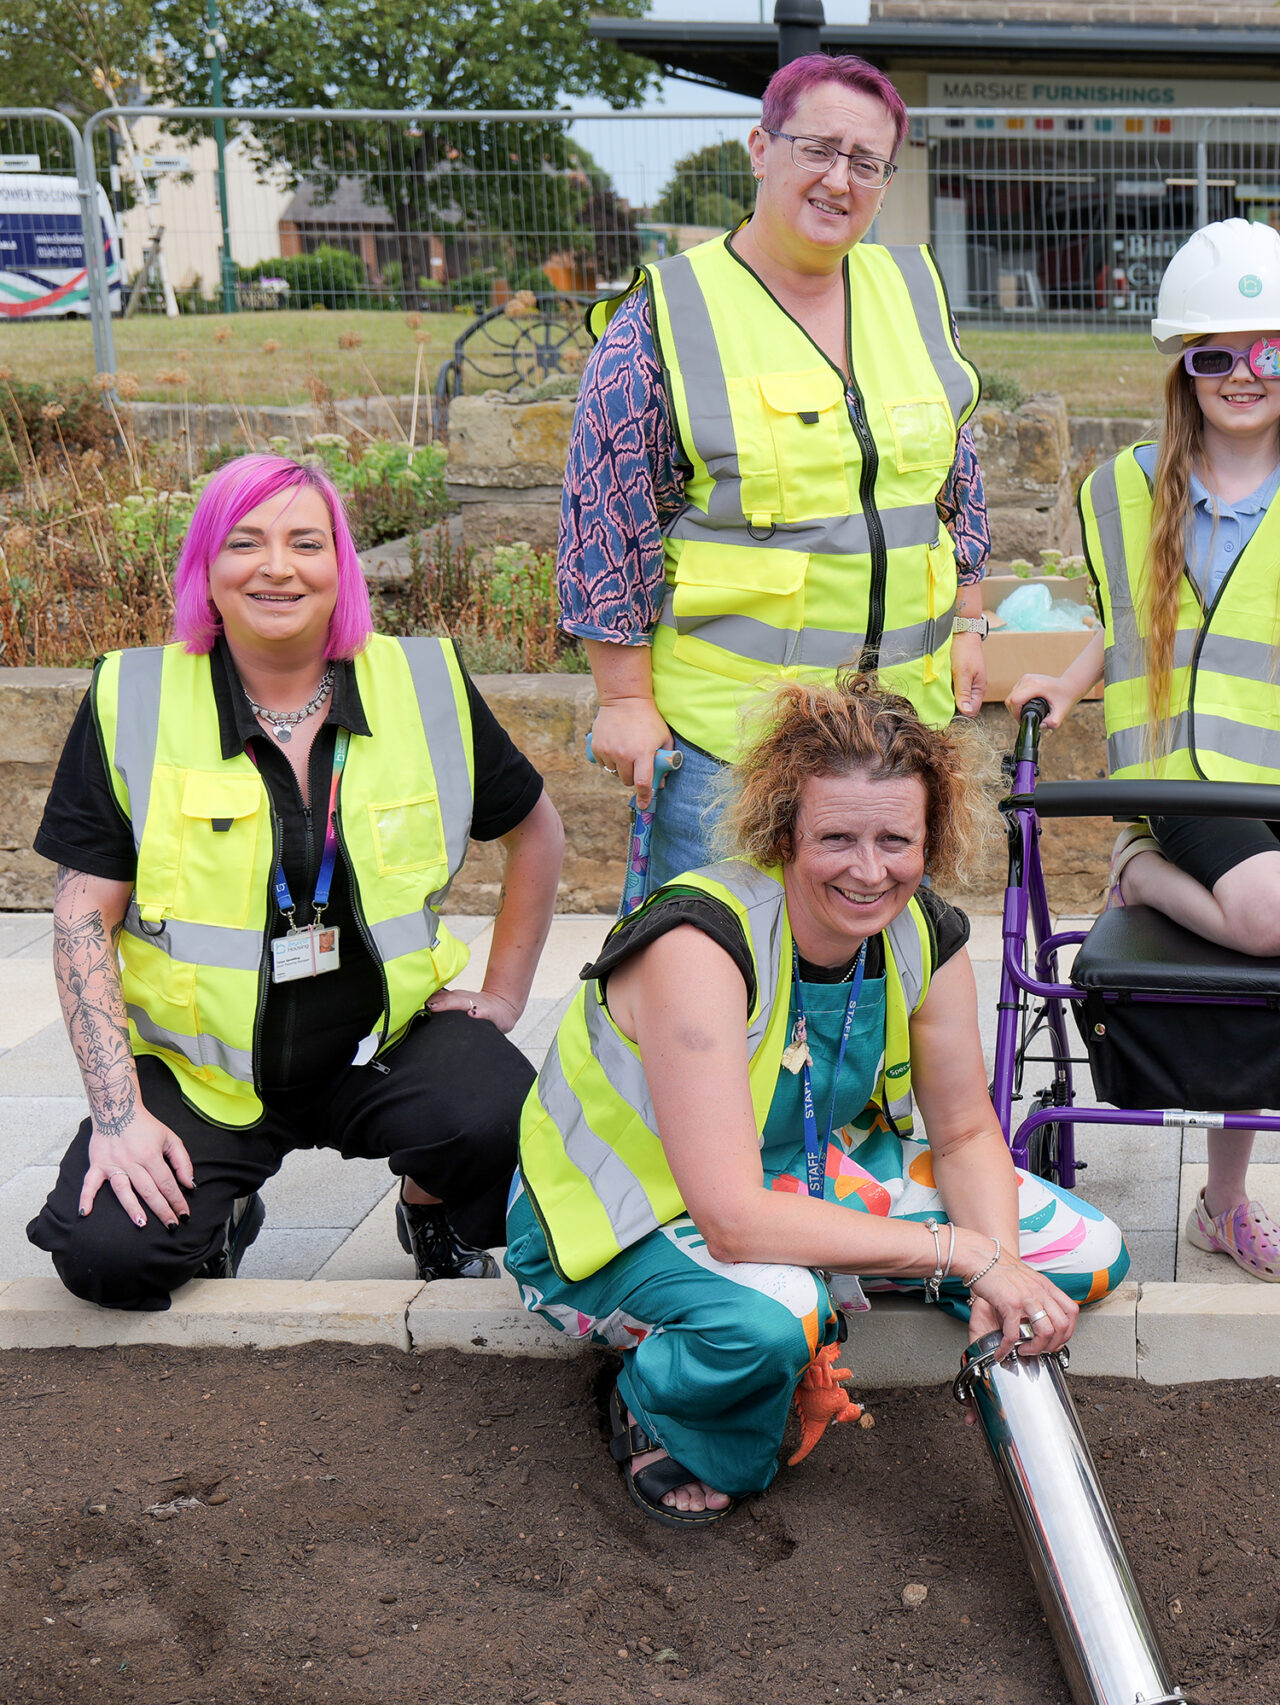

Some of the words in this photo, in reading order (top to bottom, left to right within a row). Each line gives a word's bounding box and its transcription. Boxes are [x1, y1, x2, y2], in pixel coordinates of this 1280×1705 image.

[943, 82, 1027, 100] MARSKE
[1032, 84, 1175, 104] FURNISHINGS
[287, 944, 310, 952] Housing
[843, 1000, 857, 1041] STAFF
[807, 1152, 820, 1191] STAFF
